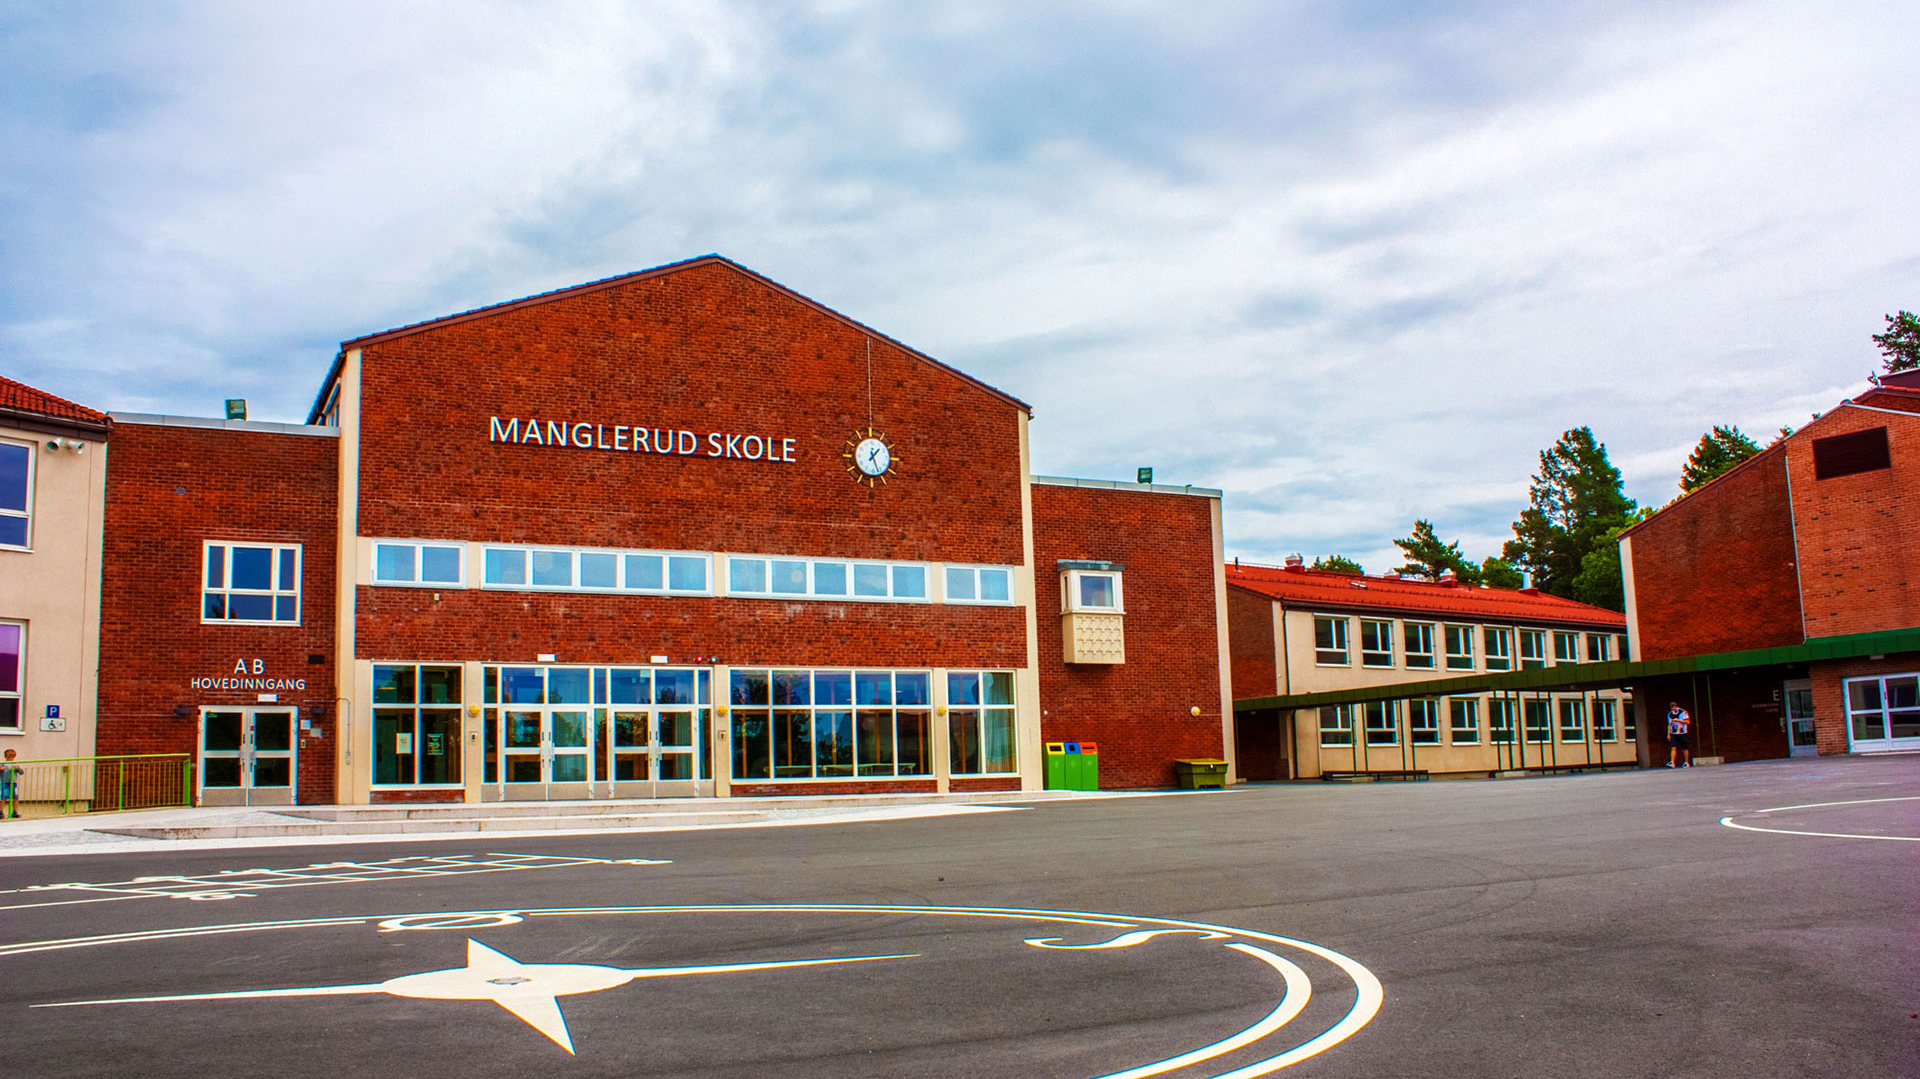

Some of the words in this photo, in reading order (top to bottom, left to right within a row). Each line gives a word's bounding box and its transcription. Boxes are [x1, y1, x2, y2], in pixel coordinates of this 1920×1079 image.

[488, 416, 698, 455] MANGLERUD
[707, 432, 797, 463] SKOLE
[234, 658, 248, 674] A
[252, 658, 265, 674] B
[191, 677, 306, 690] HOVEDINNGANG
[1772, 689, 1780, 701] E
[49, 706, 58, 717] P
